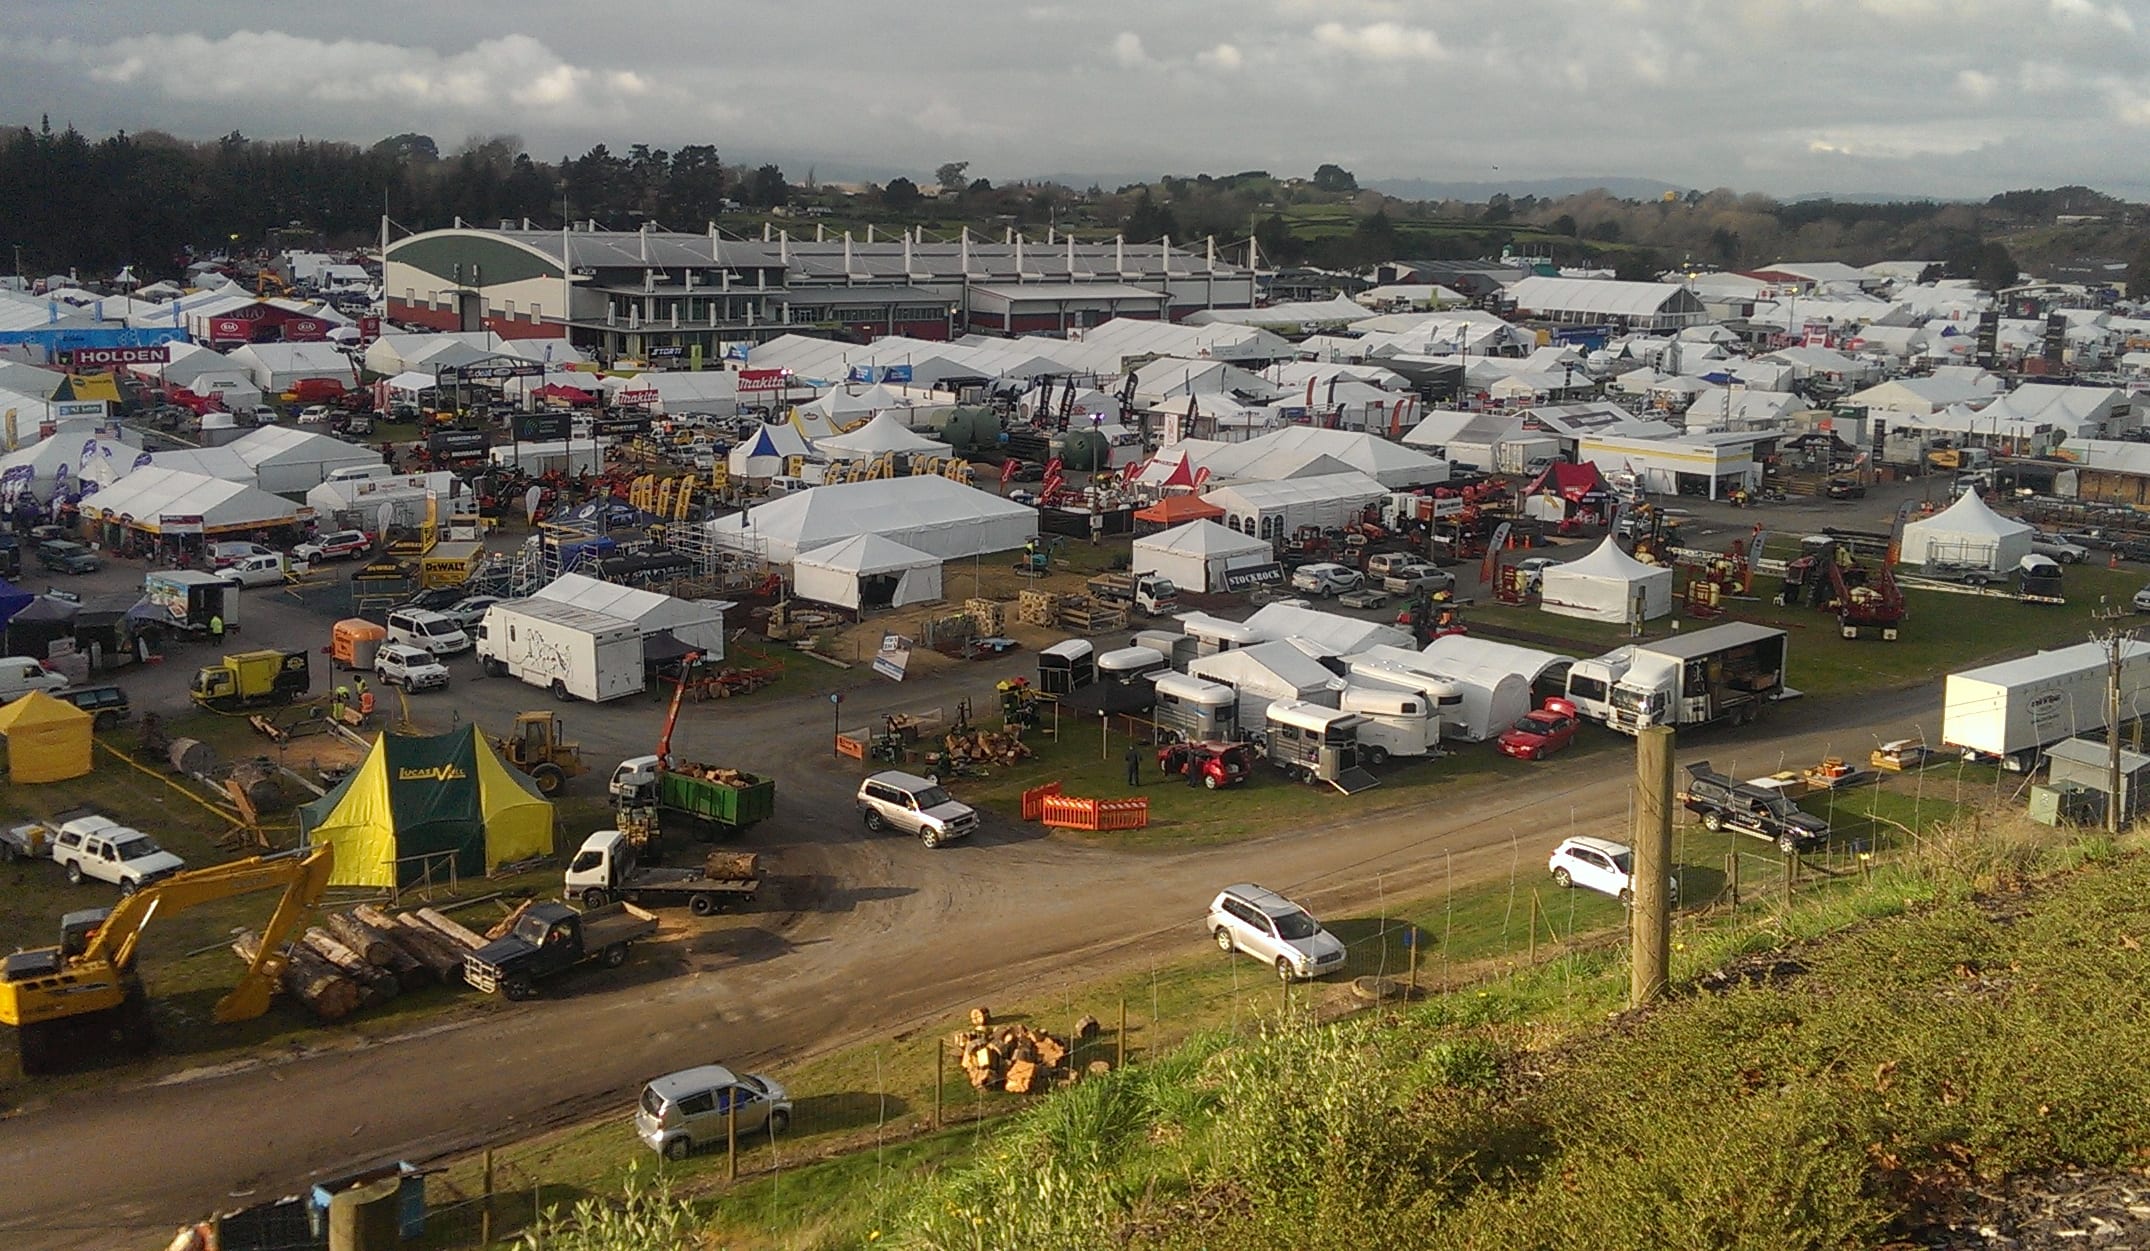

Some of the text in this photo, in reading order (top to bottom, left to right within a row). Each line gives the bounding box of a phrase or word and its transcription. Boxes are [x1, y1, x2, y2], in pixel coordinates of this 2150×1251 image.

[81, 350, 164, 362] HOLDEN
[739, 377, 785, 389] makita
[621, 391, 658, 403] makita
[1229, 569, 1280, 585] STOCKROCK
